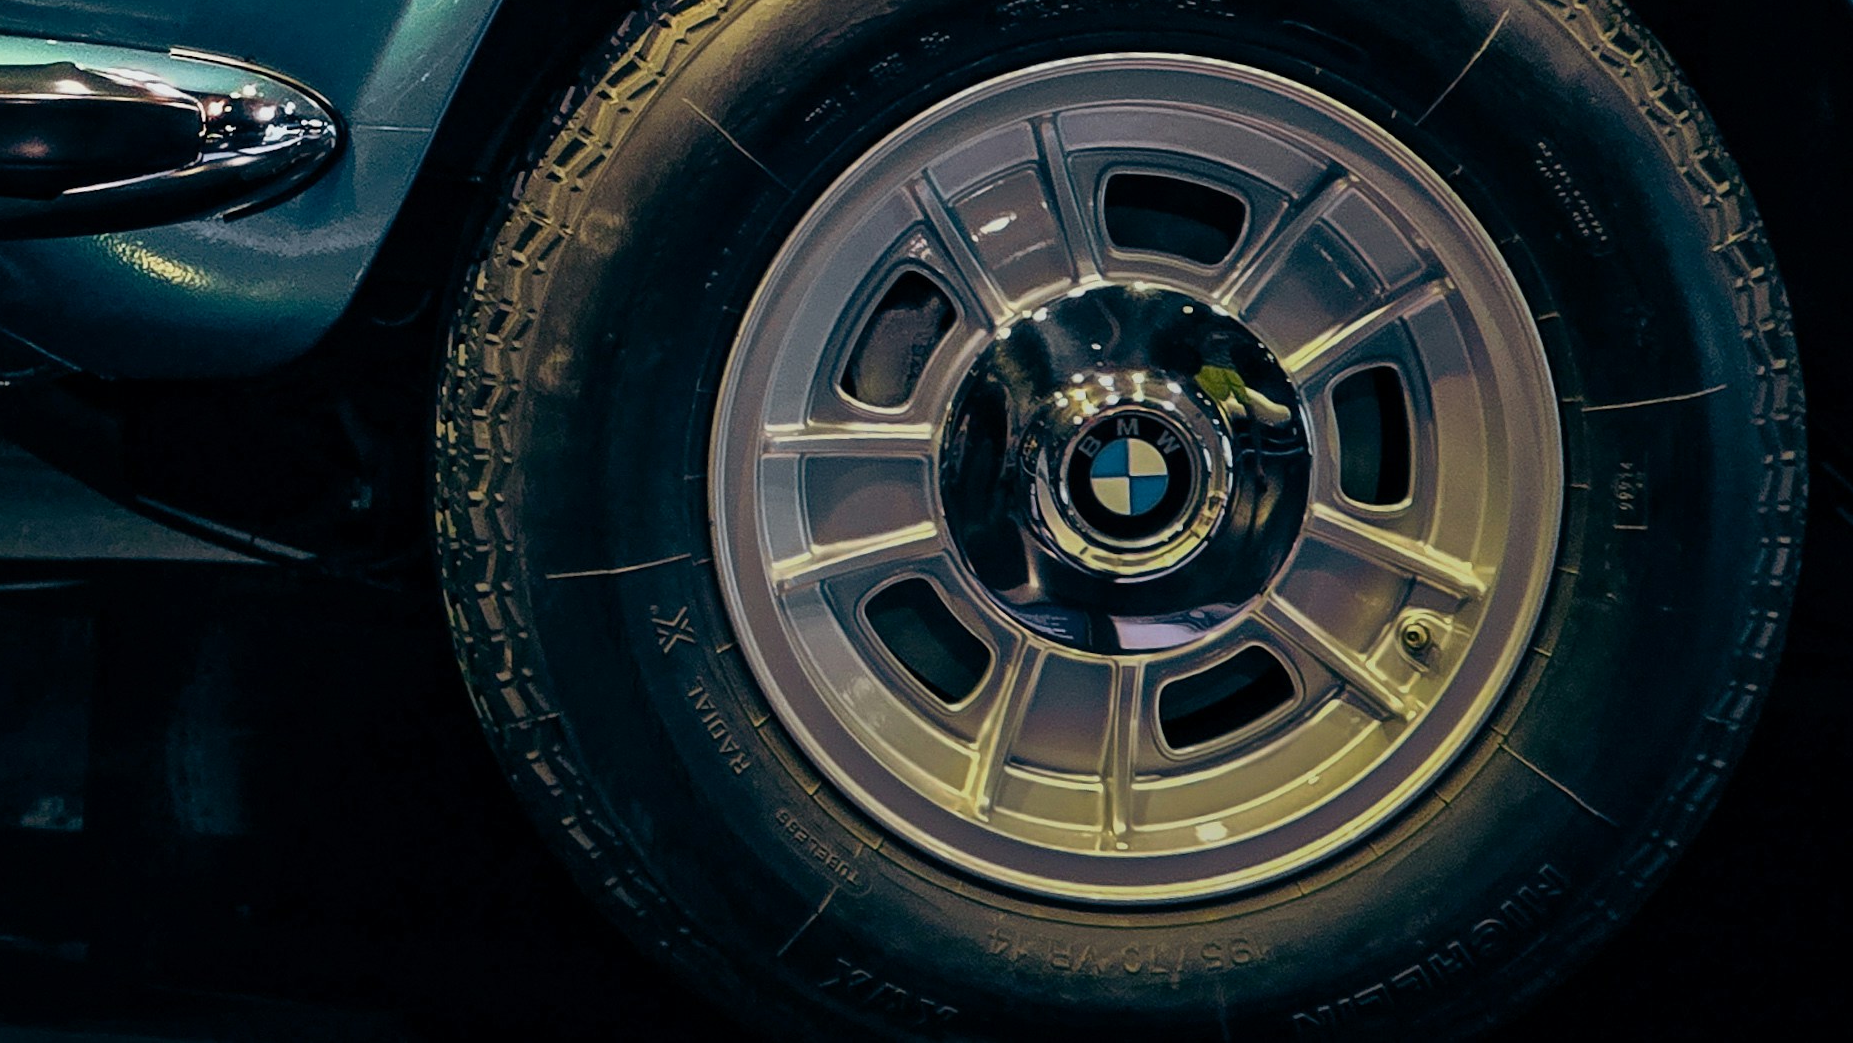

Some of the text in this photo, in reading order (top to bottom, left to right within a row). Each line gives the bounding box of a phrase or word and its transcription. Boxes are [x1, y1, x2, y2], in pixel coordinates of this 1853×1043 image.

[1078, 417, 1182, 458] BMW
[684, 673, 751, 776] RADIAL
[774, 808, 862, 886] TUBELESS
[1291, 862, 1570, 1029] MICHELIN
